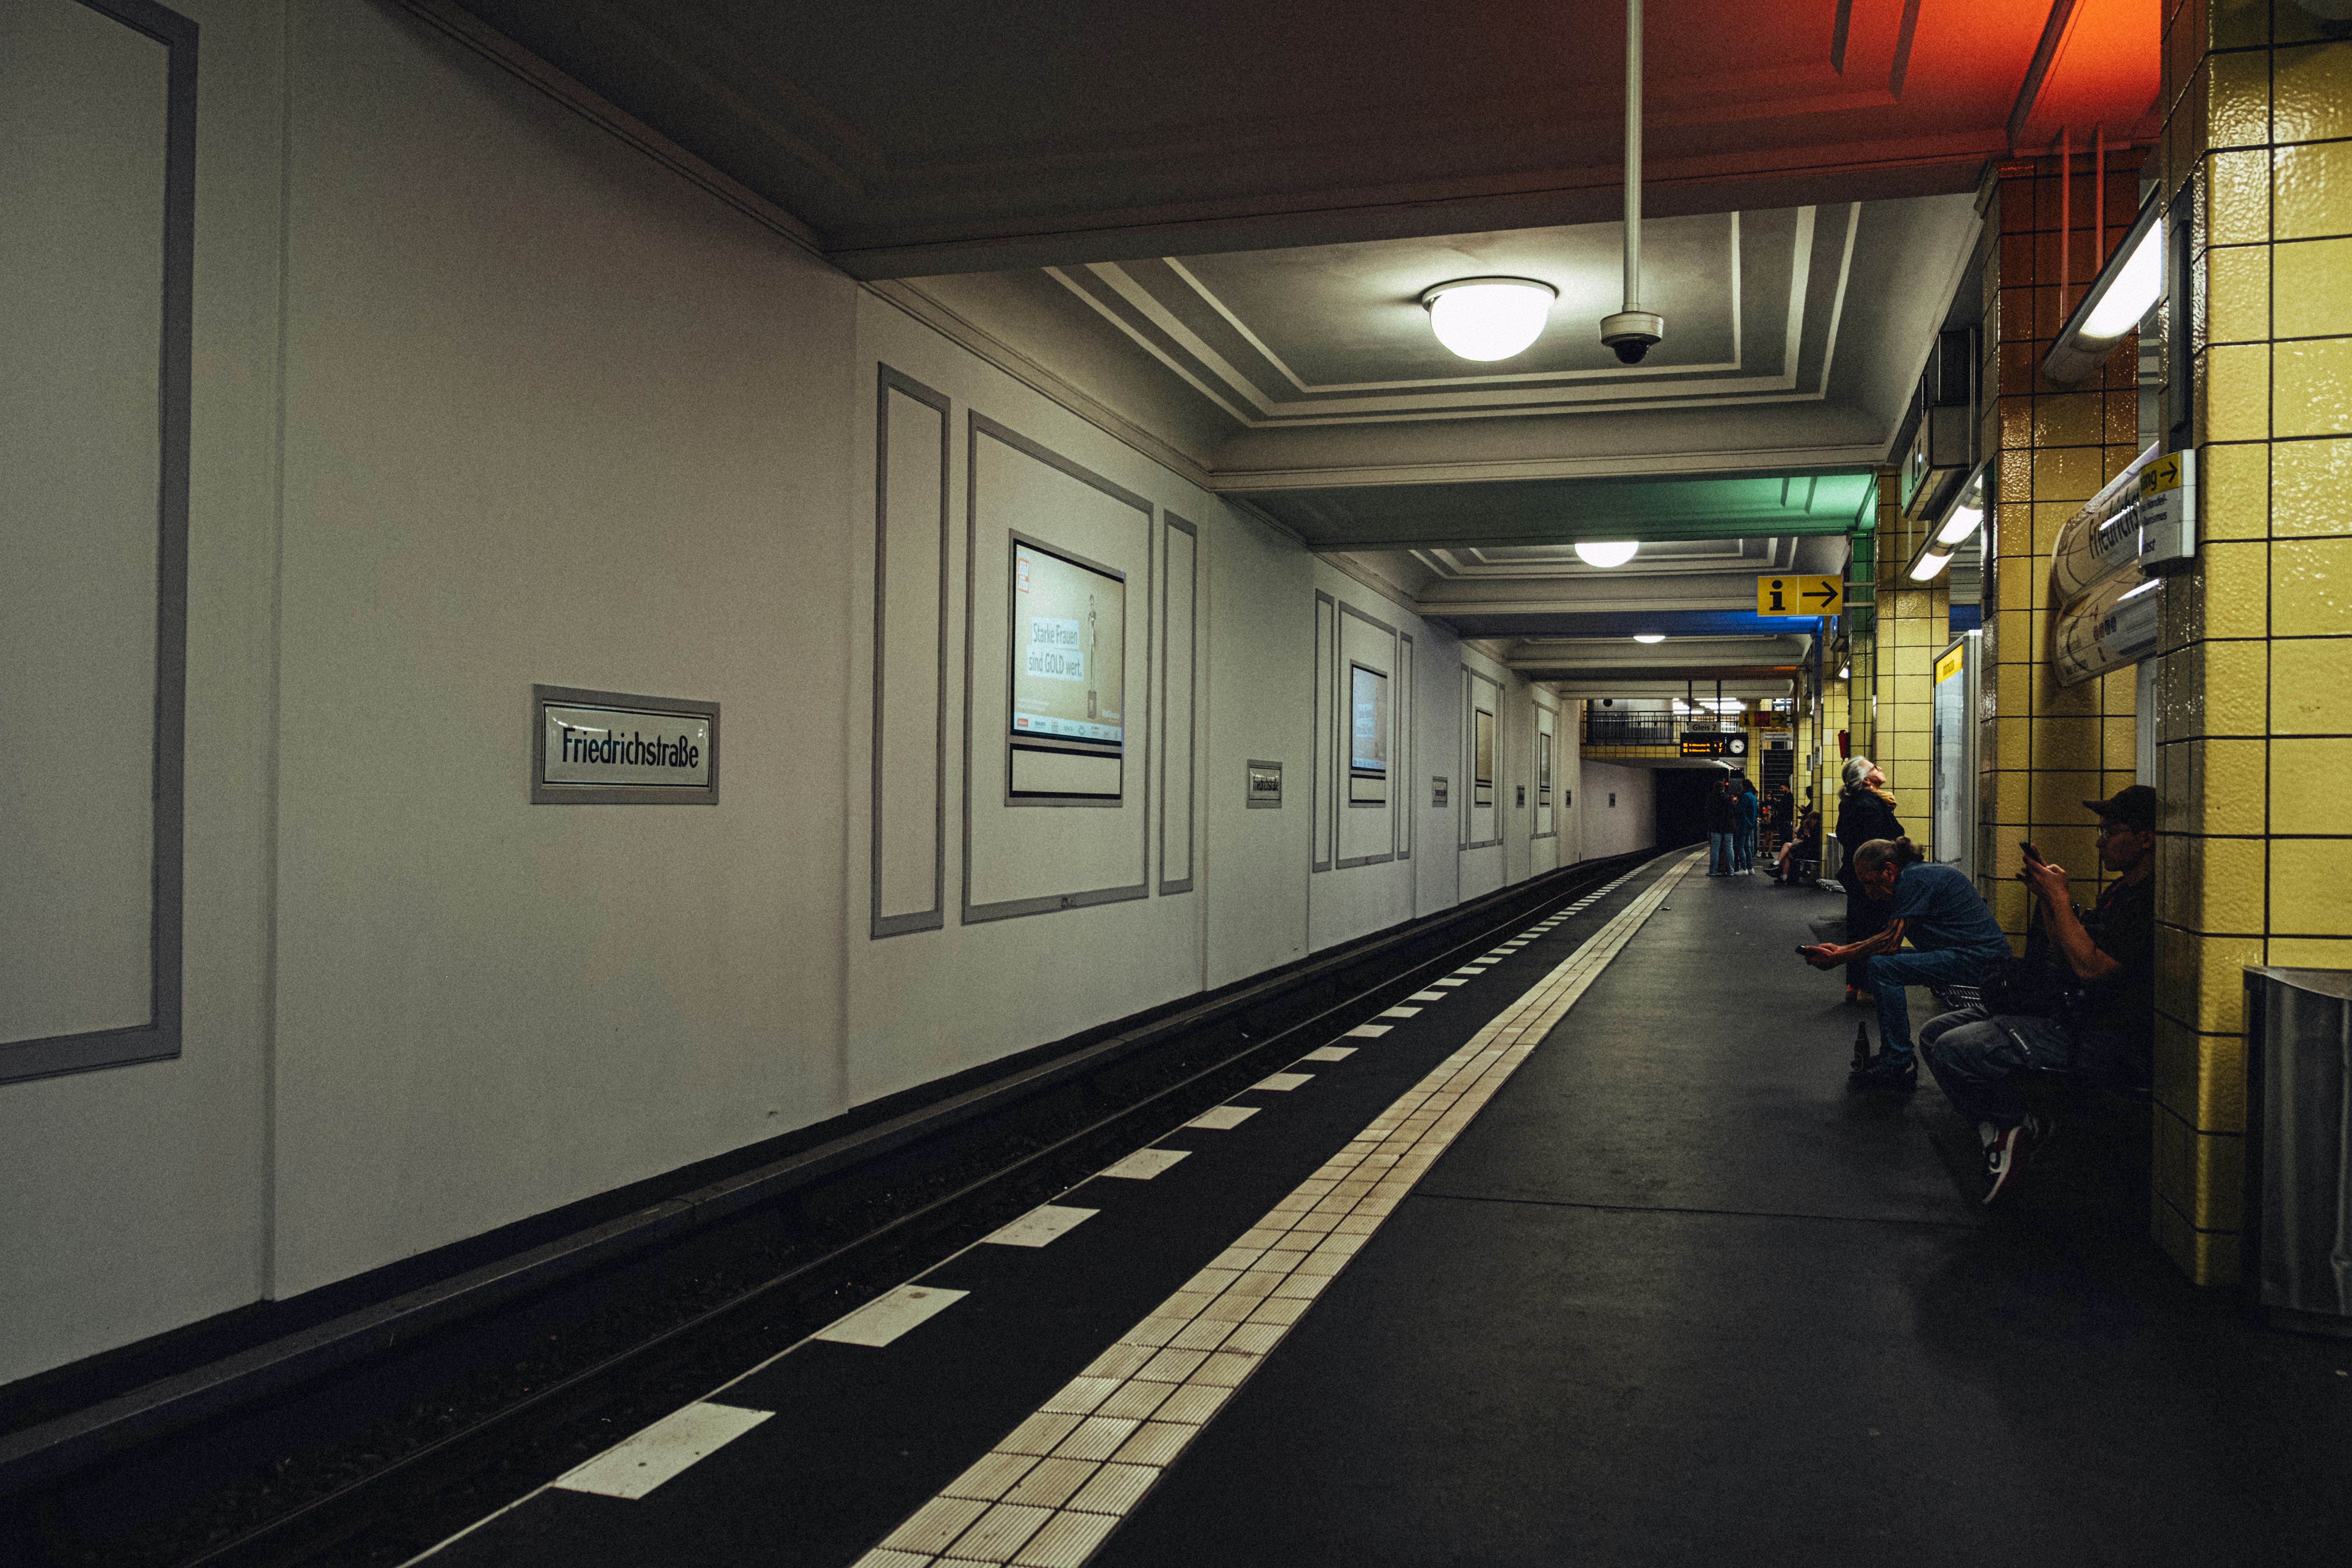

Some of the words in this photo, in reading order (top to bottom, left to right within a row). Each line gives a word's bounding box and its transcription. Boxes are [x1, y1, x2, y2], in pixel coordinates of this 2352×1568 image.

[1034, 623, 1055, 643] Starke
[1057, 625, 1077, 645] Frauen
[1029, 651, 1043, 672] sind
[1045, 653, 1064, 674] GOLD
[1066, 659, 1082, 677] wert.
[563, 727, 699, 768] Friedrichstraße
